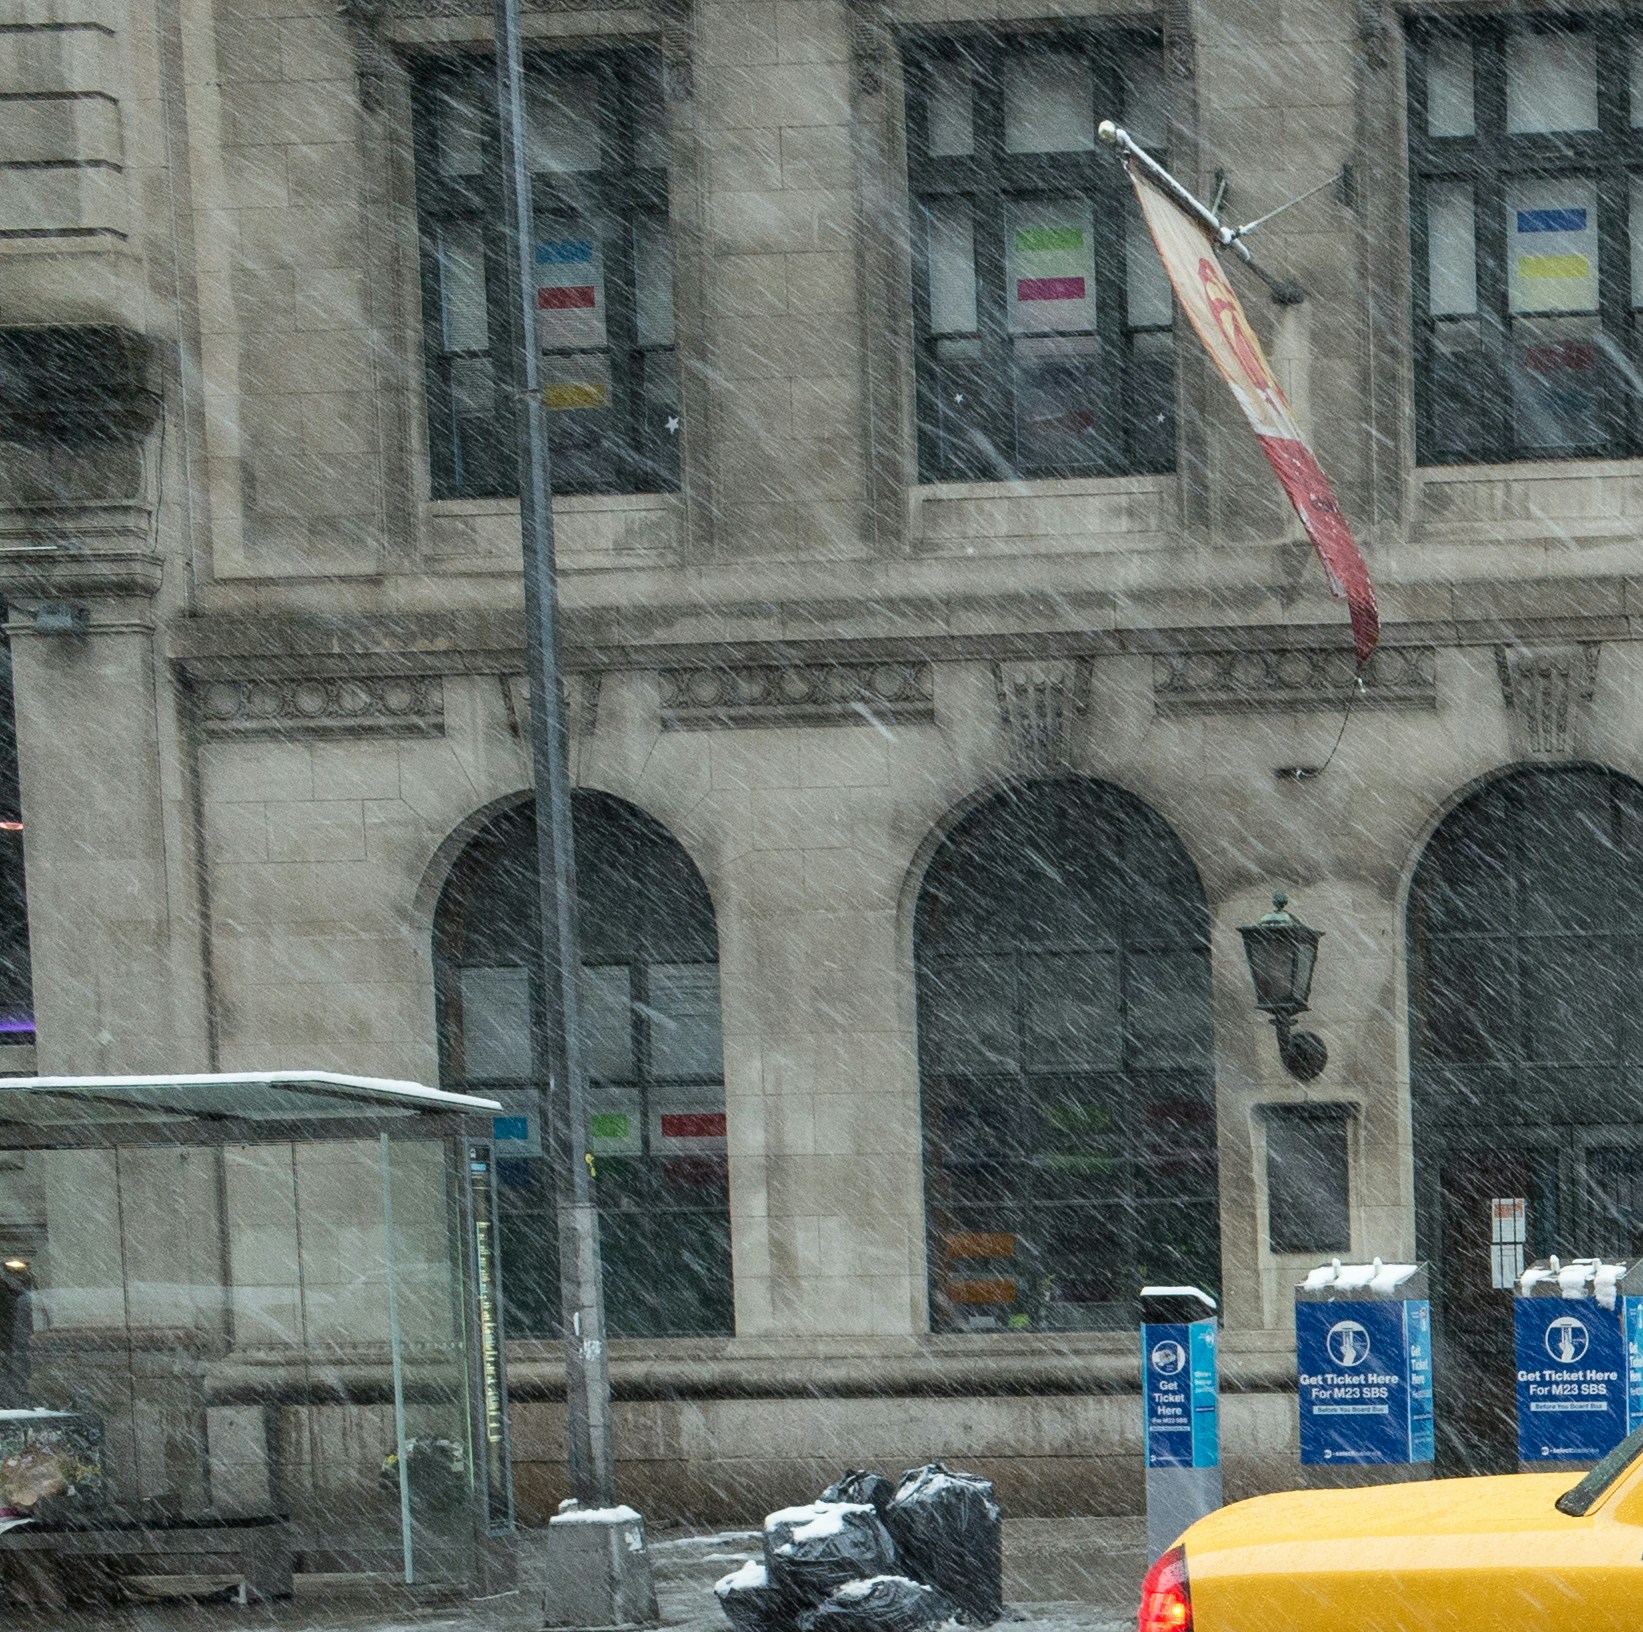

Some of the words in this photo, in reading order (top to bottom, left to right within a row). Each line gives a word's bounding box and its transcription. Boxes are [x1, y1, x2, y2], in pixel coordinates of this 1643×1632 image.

[1300, 1373, 1322, 1386] Get
[1325, 1373, 1365, 1385] Ticket
[1368, 1373, 1399, 1385] Here
[1518, 1370, 1541, 1382] Get
[1544, 1370, 1584, 1382] Ticket
[1586, 1369, 1618, 1381] Here
[1159, 1380, 1178, 1391] Get
[1529, 1384, 1550, 1396] For
[1551, 1384, 1579, 1396] M23
[1580, 1383, 1607, 1396] SBS
[1153, 1393, 1185, 1403] Ticket
[1311, 1388, 1334, 1399] For
[1334, 1387, 1361, 1399] M23
[1363, 1387, 1389, 1398] SBS
[1157, 1406, 1182, 1416] Here
